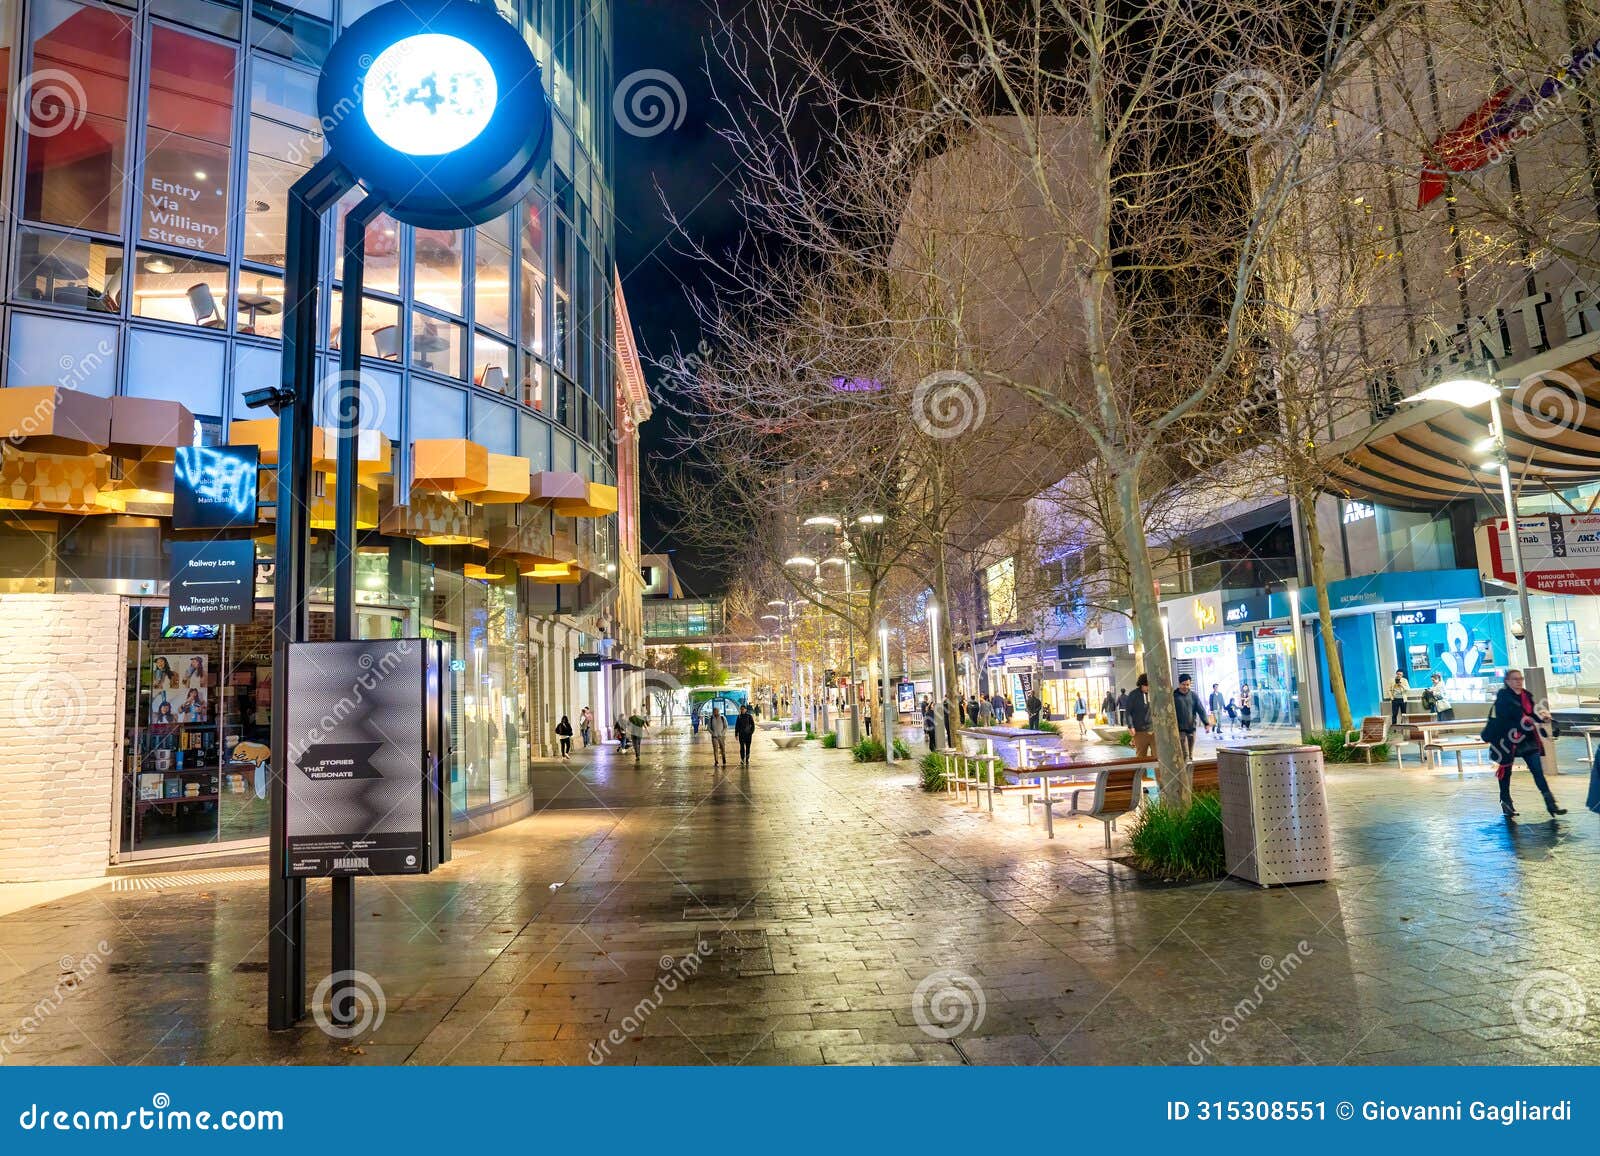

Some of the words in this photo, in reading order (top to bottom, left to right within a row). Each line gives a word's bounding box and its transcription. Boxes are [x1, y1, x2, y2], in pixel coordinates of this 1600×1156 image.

[151, 177, 201, 201] Entry
[150, 194, 179, 211] Via
[150, 210, 218, 236] William
[148, 227, 205, 249] Street
[1343, 501, 1375, 525] ANZ
[1523, 535, 1539, 543] nab
[1577, 534, 1596, 543] ANZ
[188, 560, 216, 568] Railway
[1537, 581, 1555, 589] HAY
[1557, 579, 1591, 588] STREET
[190, 596, 220, 604] Through
[180, 604, 218, 613] Wellington
[1395, 615, 1415, 624] ANZ
[1184, 644, 1219, 654] OPTUS
